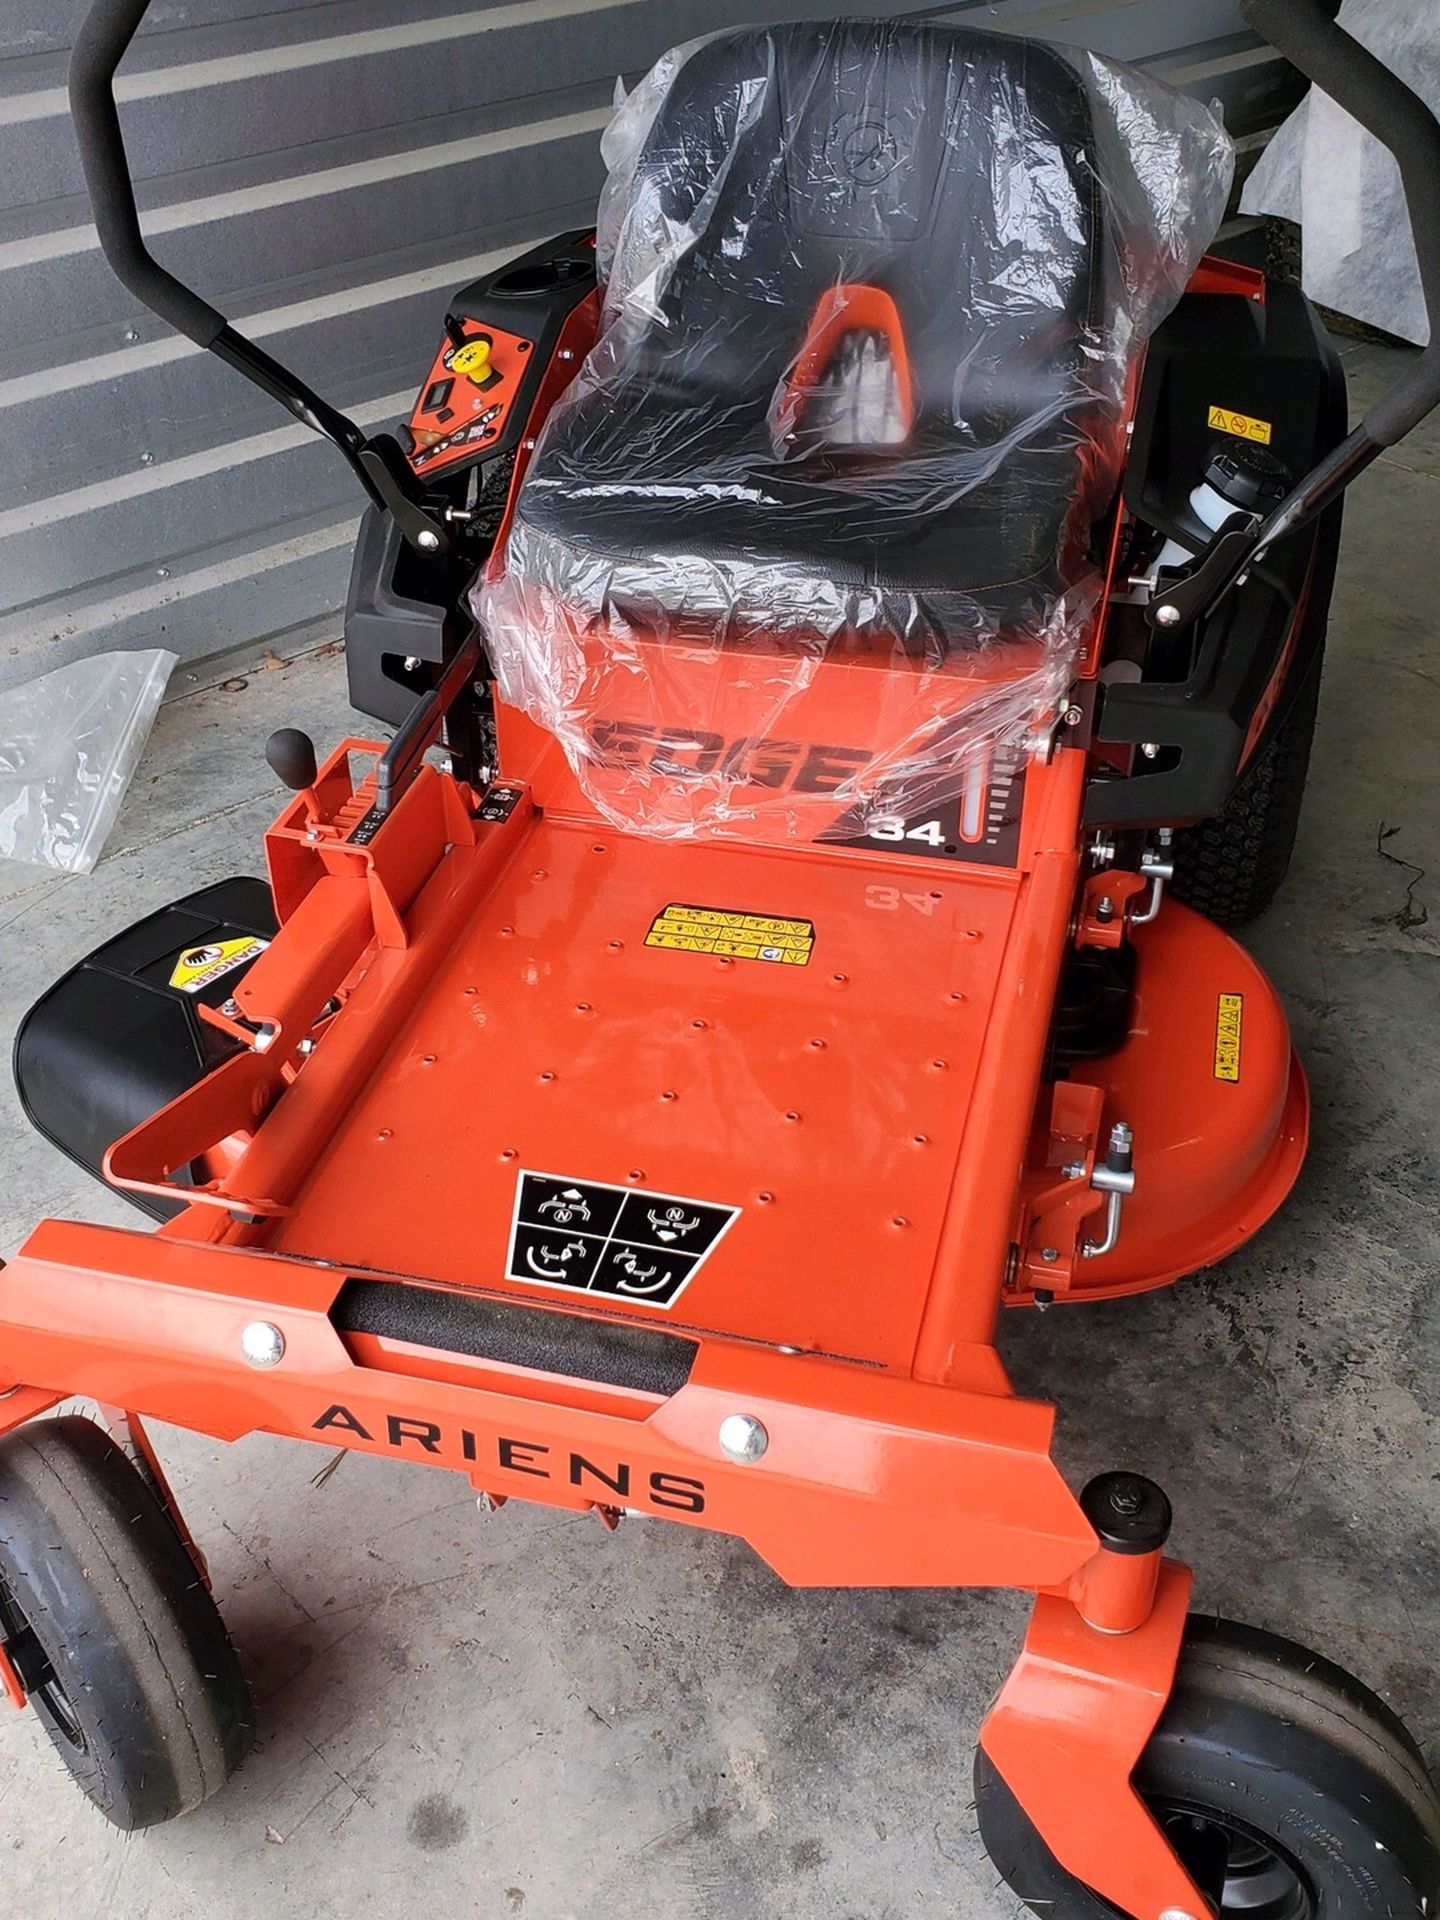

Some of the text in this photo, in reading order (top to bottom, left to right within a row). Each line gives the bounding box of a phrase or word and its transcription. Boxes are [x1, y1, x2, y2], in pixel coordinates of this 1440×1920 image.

[588, 719, 875, 793] EDGE
[868, 818, 946, 846] 34
[191, 945, 262, 986] DANGER
[556, 1209, 570, 1221] N
[669, 1208, 682, 1220] N
[311, 1404, 706, 1514] ARIENS
